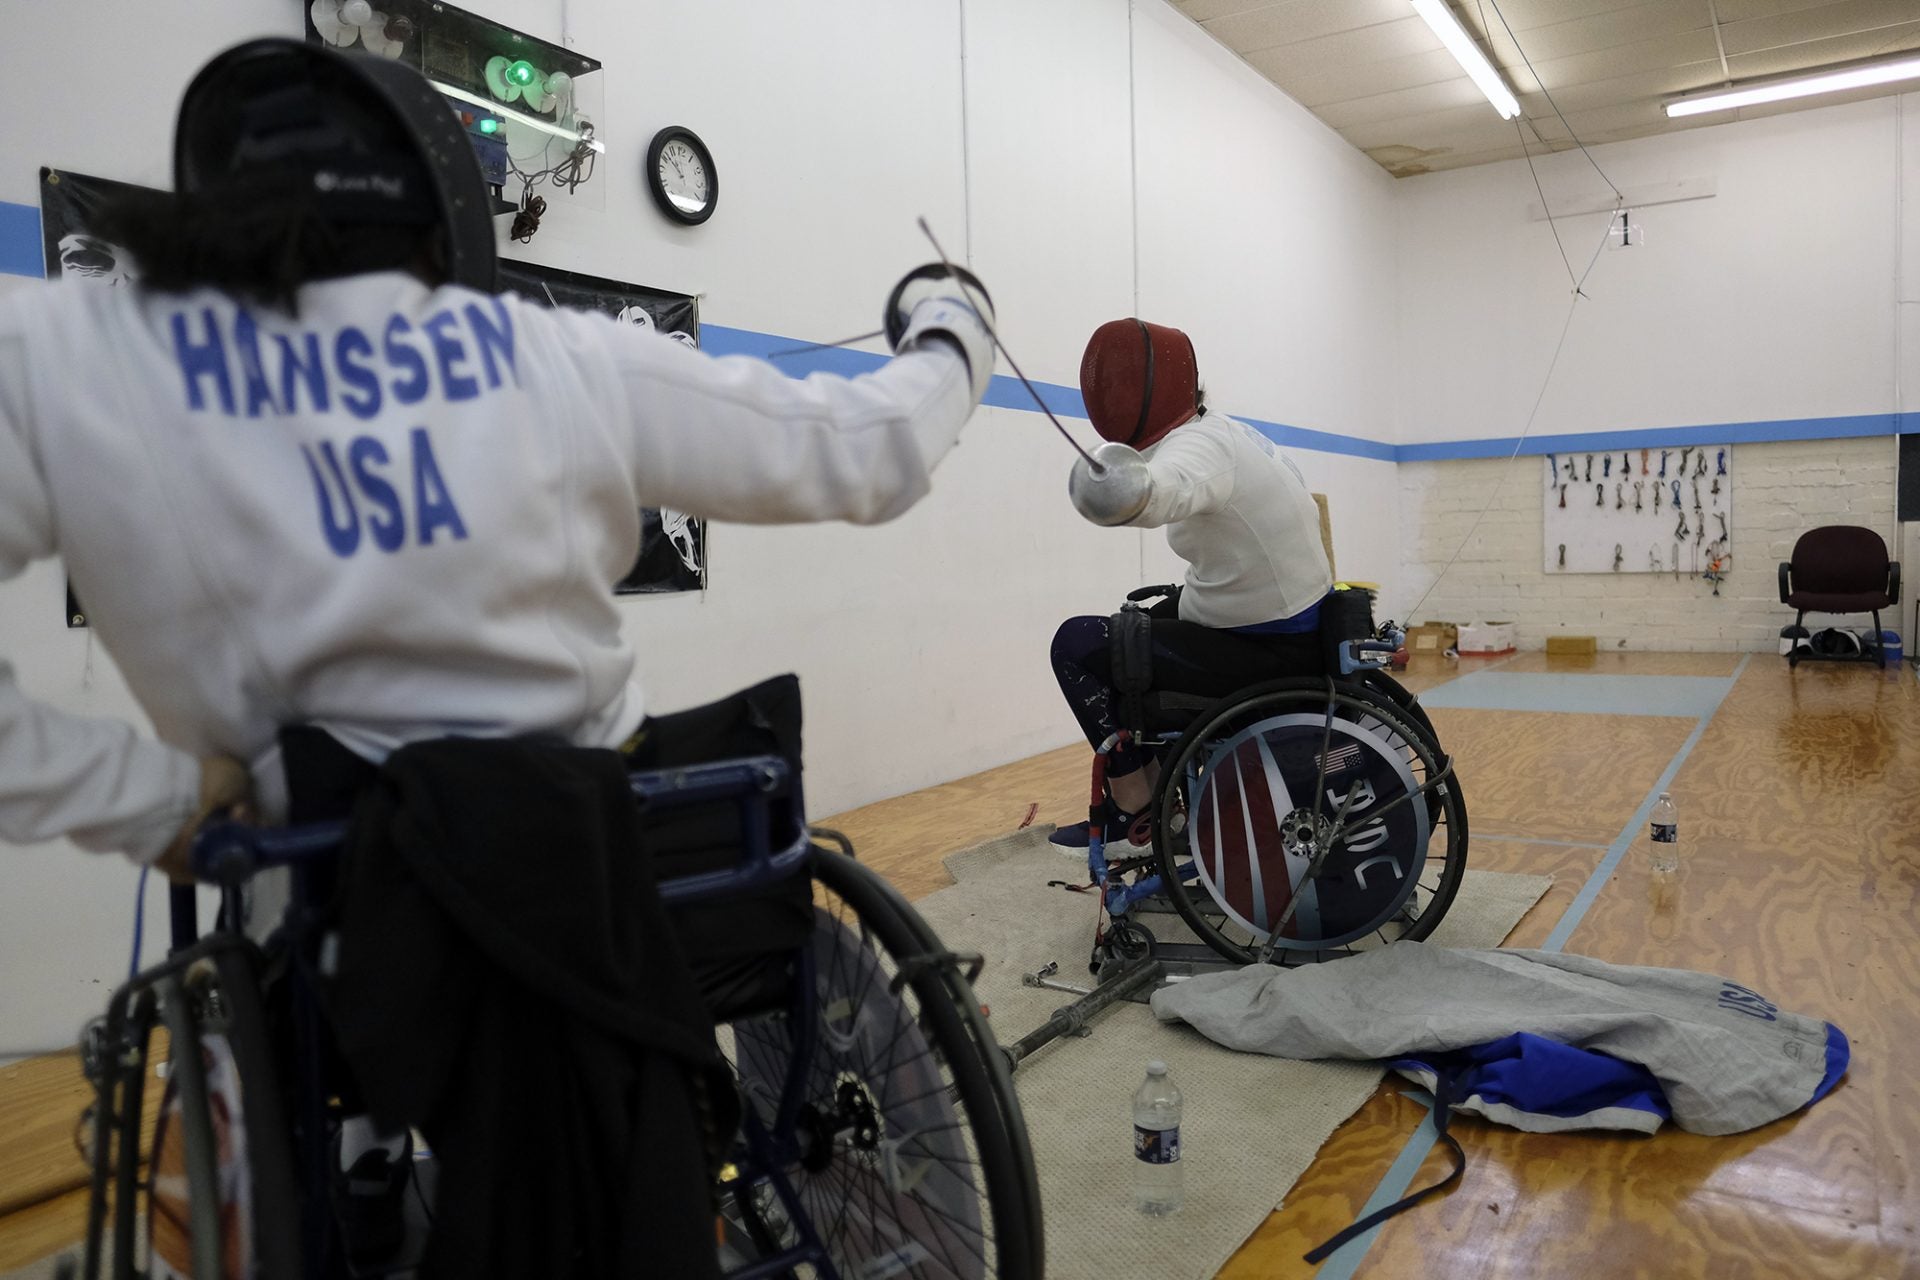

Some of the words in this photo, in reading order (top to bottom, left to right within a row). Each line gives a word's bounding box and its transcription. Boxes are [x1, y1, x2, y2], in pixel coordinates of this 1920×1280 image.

[1618, 212, 1632, 247] 1
[171, 297, 520, 420] HANSSEN
[300, 426, 469, 558] USA
